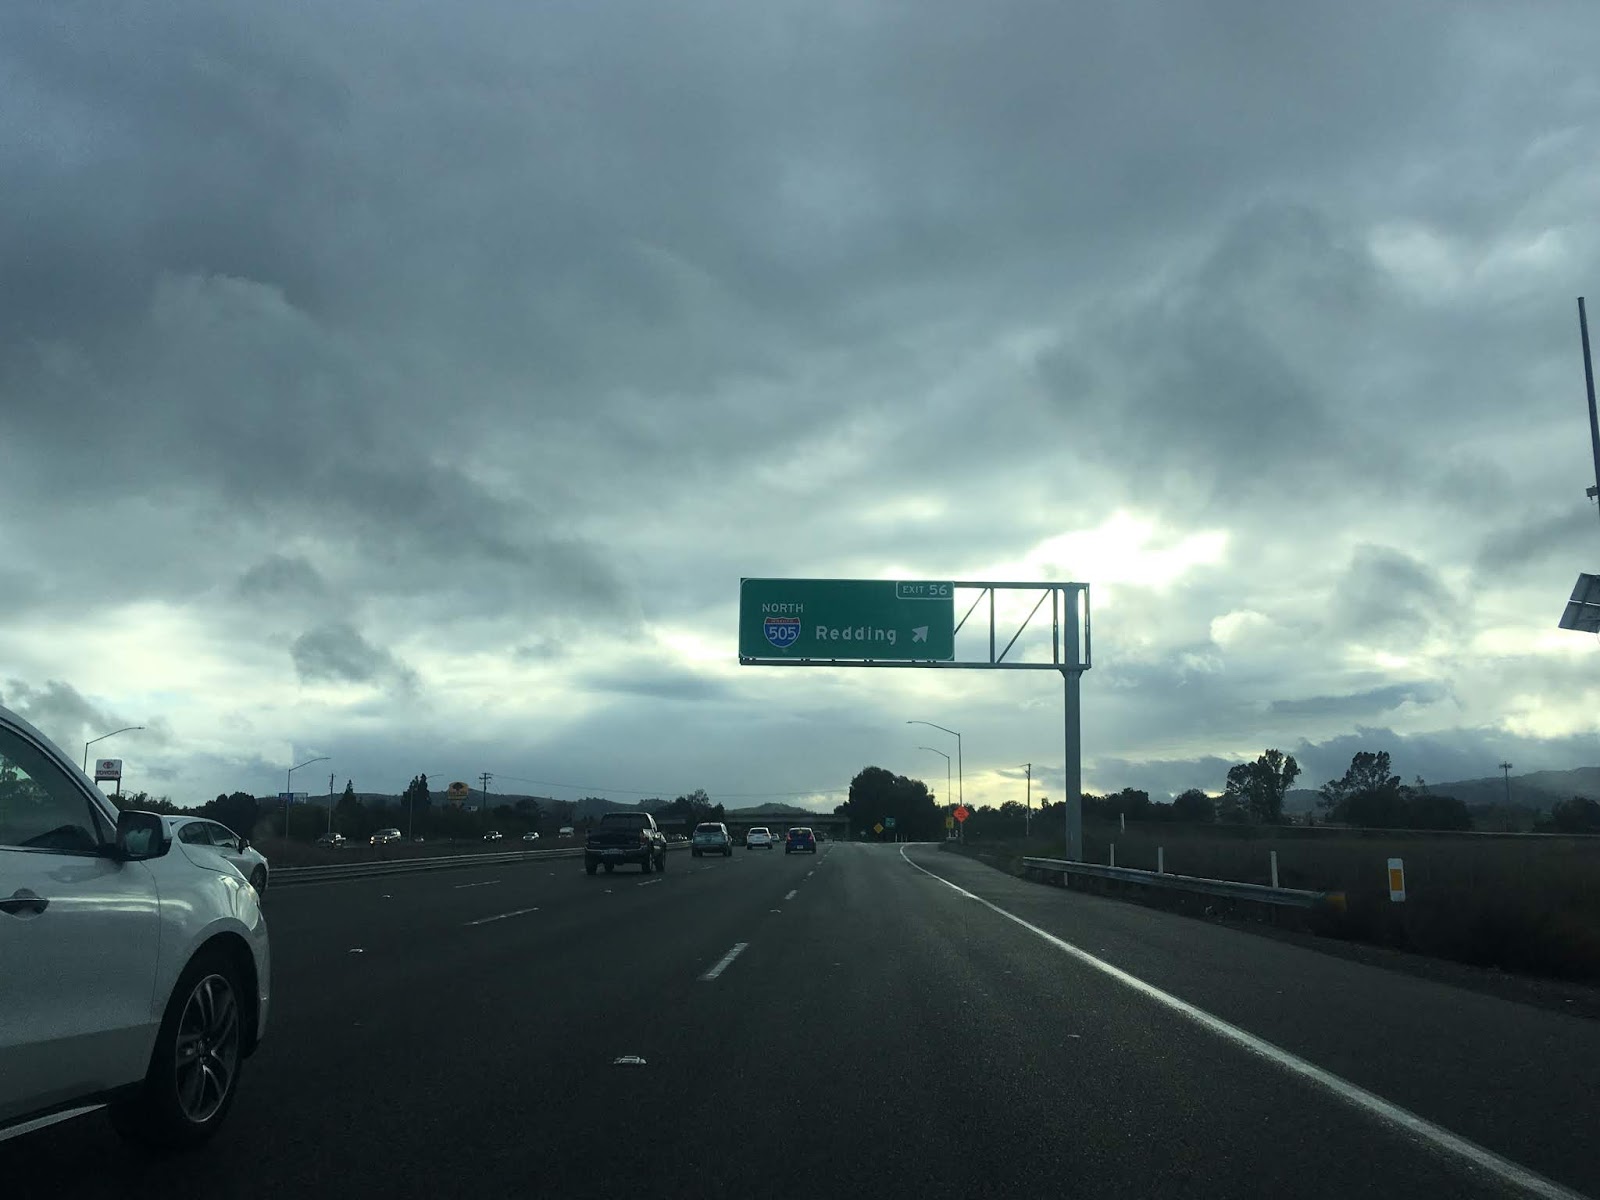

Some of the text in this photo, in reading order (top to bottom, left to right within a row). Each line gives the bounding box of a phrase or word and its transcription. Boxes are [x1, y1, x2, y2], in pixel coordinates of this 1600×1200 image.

[903, 584, 948, 595] EXIT 56
[762, 603, 804, 613] NORTH
[769, 626, 797, 640] 505
[816, 625, 897, 645] Redding
